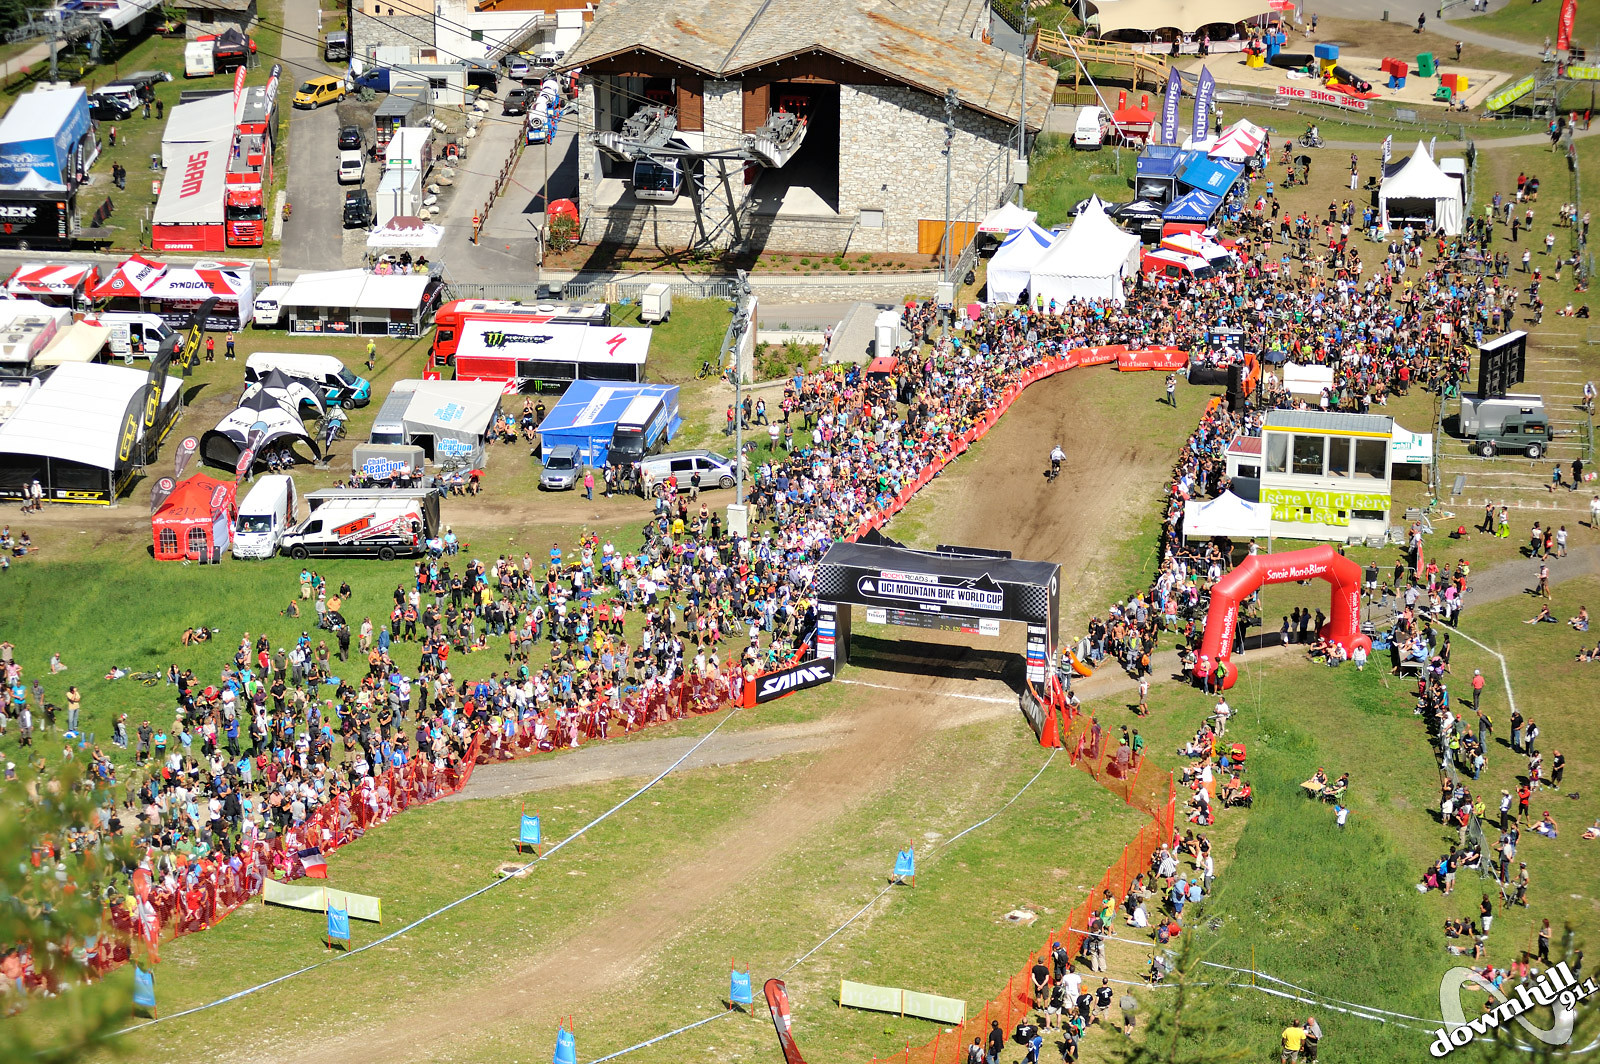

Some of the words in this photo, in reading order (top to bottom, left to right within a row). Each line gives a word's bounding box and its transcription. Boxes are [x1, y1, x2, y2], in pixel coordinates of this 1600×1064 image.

[1279, 86, 1305, 97] Bike
[1311, 90, 1336, 103] Bike
[1196, 80, 1211, 138] SHIMANO
[1341, 96, 1365, 109] Bike
[1165, 82, 1179, 140] SHIMANO
[180, 150, 209, 199] SRAM
[15, 281, 75, 290] SYNDICATE
[169, 281, 215, 290] SYNDICATE
[504, 334, 546, 342] MONSTER
[438, 442, 473, 452] Reaction
[363, 460, 404, 475] Reaction
[367, 457, 386, 465] Chain
[1261, 490, 1302, 505] Isère
[1306, 493, 1330, 507] Val
[1334, 495, 1390, 510] d'Isère
[169, 507, 197, 516] #211
[1266, 567, 1289, 581] Savoie
[881, 582, 895, 593] UCI
[896, 584, 936, 598] MOUNTAIN
[938, 588, 955, 600] BIKE
[958, 590, 985, 603] WORLD
[986, 593, 1003, 604] CUP
[1218, 637, 1229, 658] Savoie
[758, 665, 831, 697] SAINT
